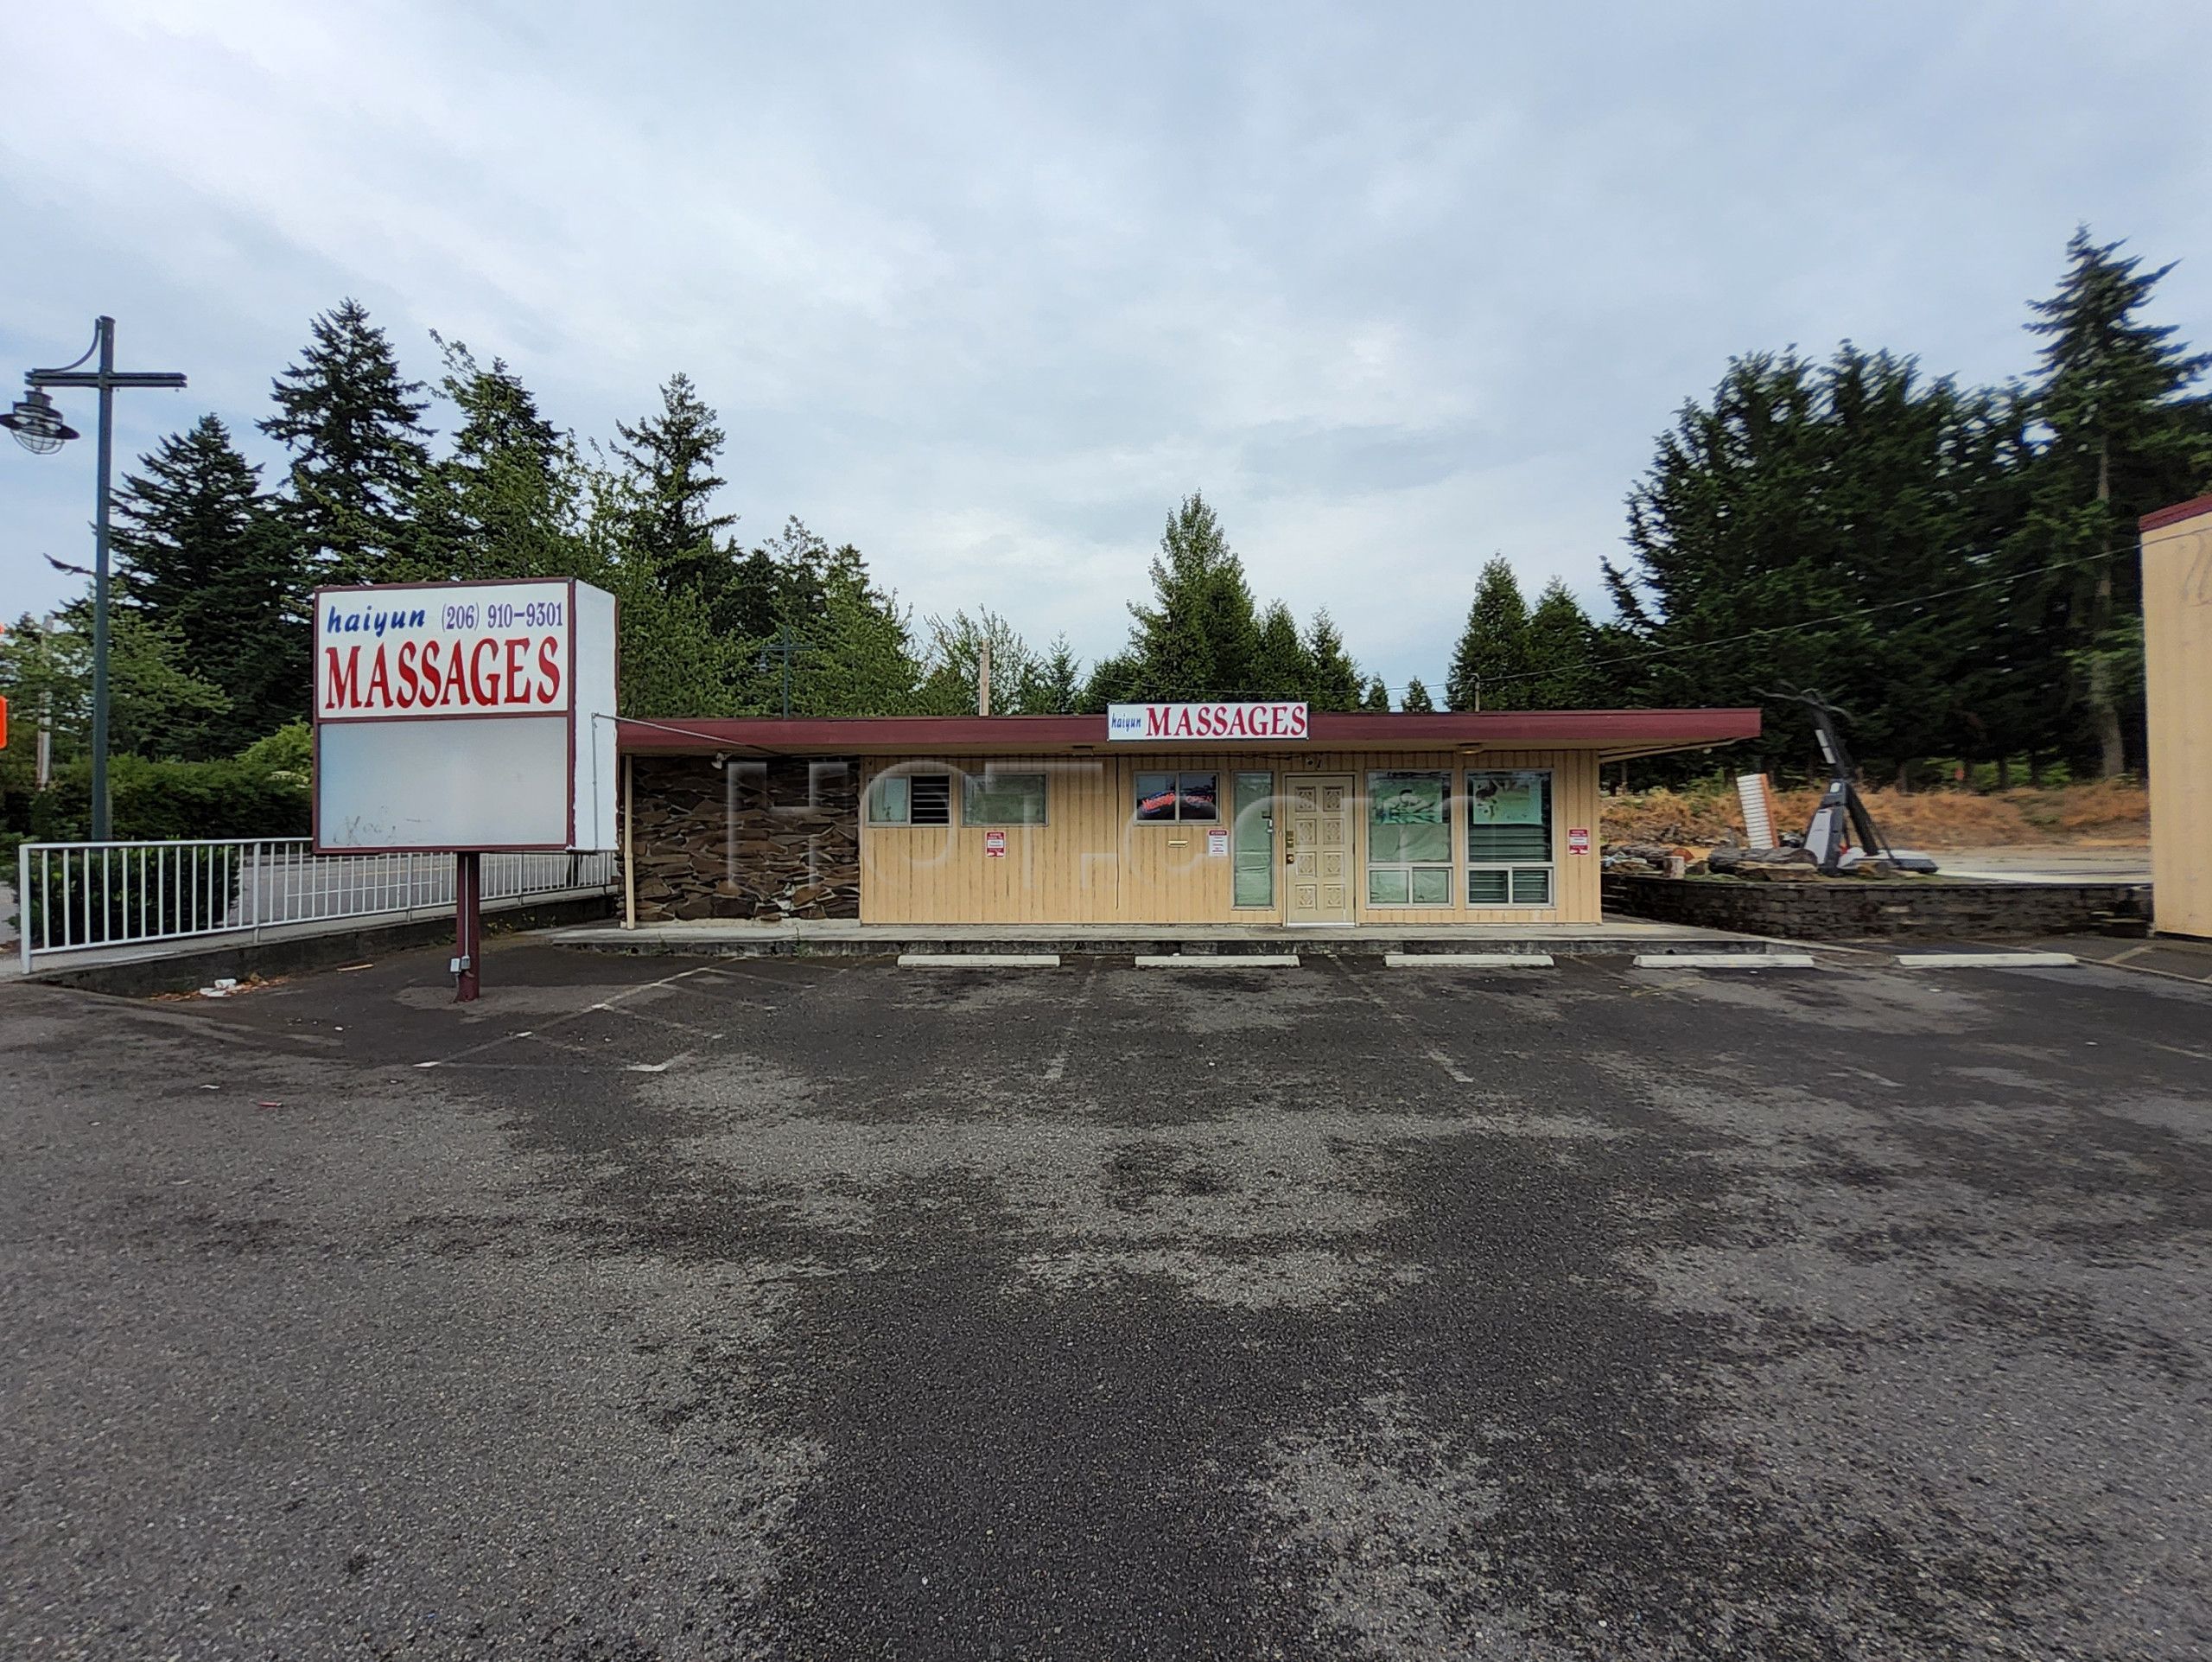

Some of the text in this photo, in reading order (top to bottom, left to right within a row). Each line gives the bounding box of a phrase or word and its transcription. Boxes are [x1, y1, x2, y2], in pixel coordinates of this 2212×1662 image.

[326, 601, 563, 637] haiyun (206) 910-9301
[324, 635, 561, 710] MASSAGES
[1111, 705, 1306, 737] haiyun MASSAGES
[1185, 793, 1214, 805] OPEN
